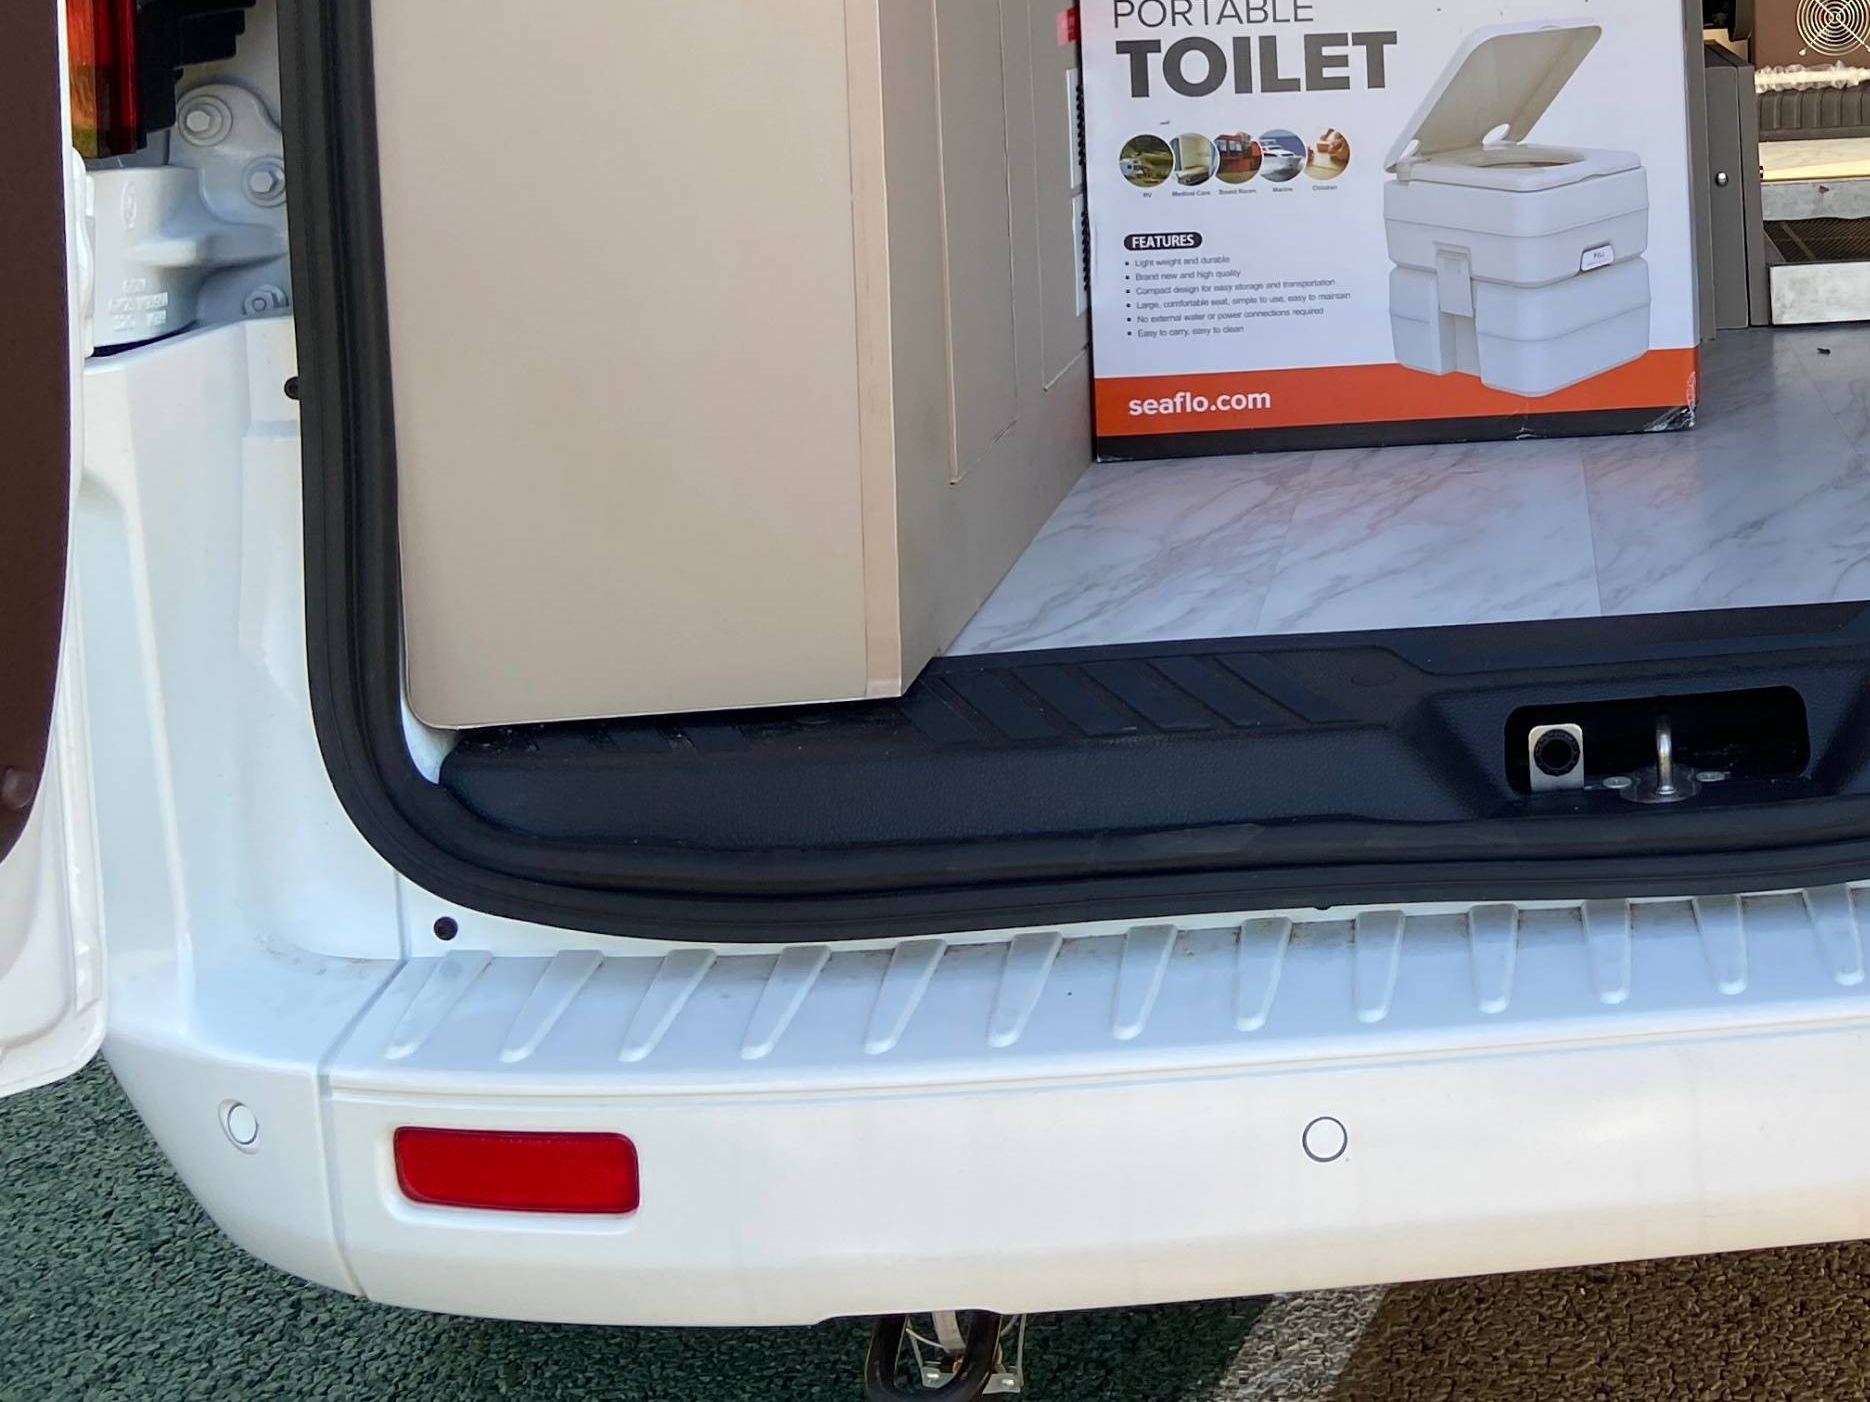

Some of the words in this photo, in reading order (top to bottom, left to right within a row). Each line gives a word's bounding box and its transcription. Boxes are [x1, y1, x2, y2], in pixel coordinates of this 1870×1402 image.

[1115, 30, 1398, 98] TOILET
[1132, 234, 1195, 248] FEATURES
[1135, 259, 1154, 268] Light
[1155, 258, 1182, 268] weight
[1183, 257, 1199, 265] and
[1200, 255, 1230, 264] durable
[1136, 273, 1160, 281] Brand
[1179, 271, 1195, 279] and
[1196, 271, 1214, 280] high
[1215, 269, 1241, 279] quality
[1136, 287, 1172, 295] Compact
[1173, 286, 1200, 295] design
[1213, 285, 1233, 293] easy
[1234, 283, 1265, 291] storage
[1265, 281, 1281, 289] and
[1282, 279, 1336, 289] transportation
[1163, 299, 1209, 307] comfortable
[1232, 296, 1258, 305] simple
[1287, 295, 1307, 303] easy
[1137, 315, 1150, 323] No
[1150, 315, 1182, 323] external
[1183, 313, 1205, 321] water
[1217, 312, 1243, 320] power
[1243, 309, 1290, 318] connections
[1291, 307, 1325, 317] required
[1137, 329, 1158, 338] Easy
[1191, 328, 1211, 336] easy
[1213, 326, 1222, 334] to
[1222, 325, 1245, 334] clean
[1128, 391, 1271, 416] seaflo.com
